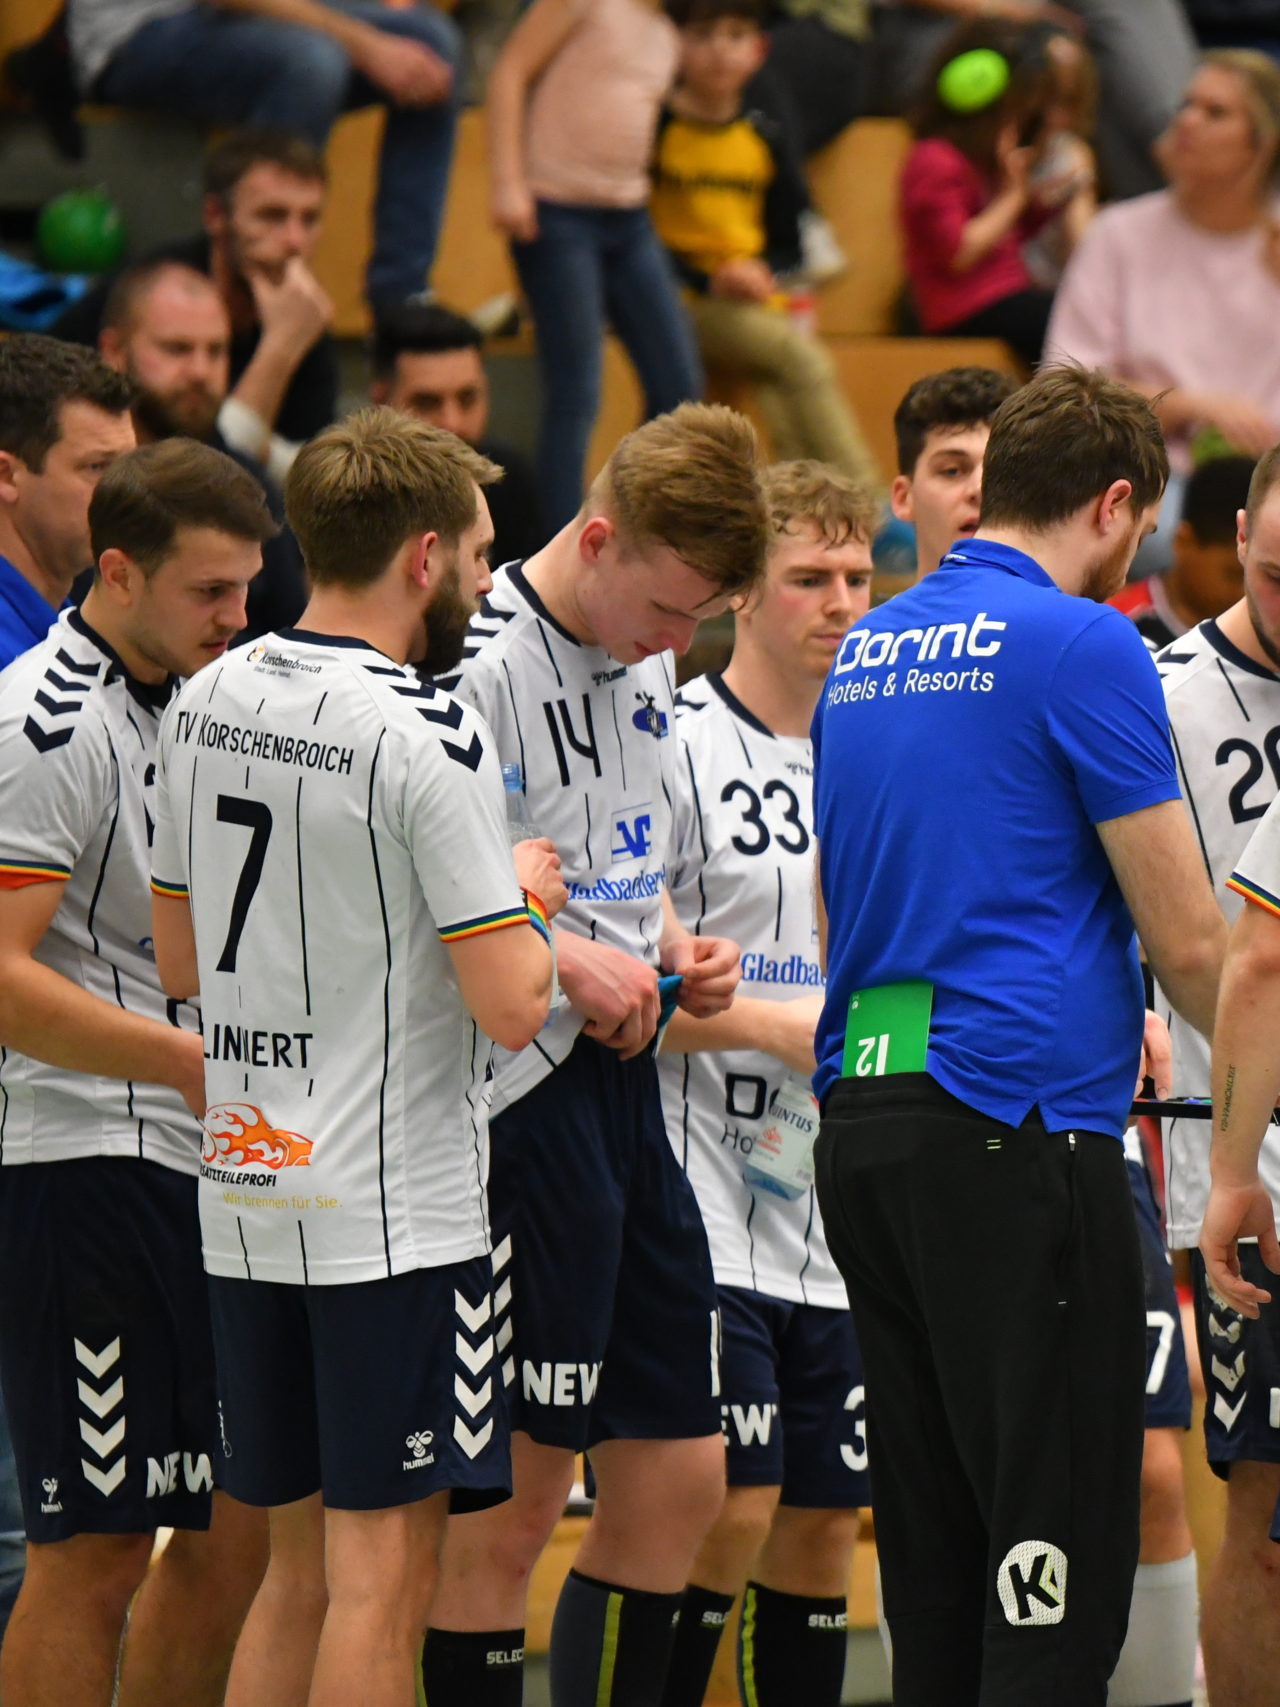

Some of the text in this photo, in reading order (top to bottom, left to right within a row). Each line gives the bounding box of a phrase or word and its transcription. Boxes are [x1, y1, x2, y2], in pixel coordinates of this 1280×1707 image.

[826, 667, 995, 710] Hotels & Resorts
[175, 711, 354, 776] TV KORSCHENBROICH
[543, 692, 602, 787] 14
[720, 779, 810, 857] 33
[215, 794, 273, 973] 7
[808, 1613, 847, 1627] SELEC
[486, 1648, 525, 1665] SELEC
